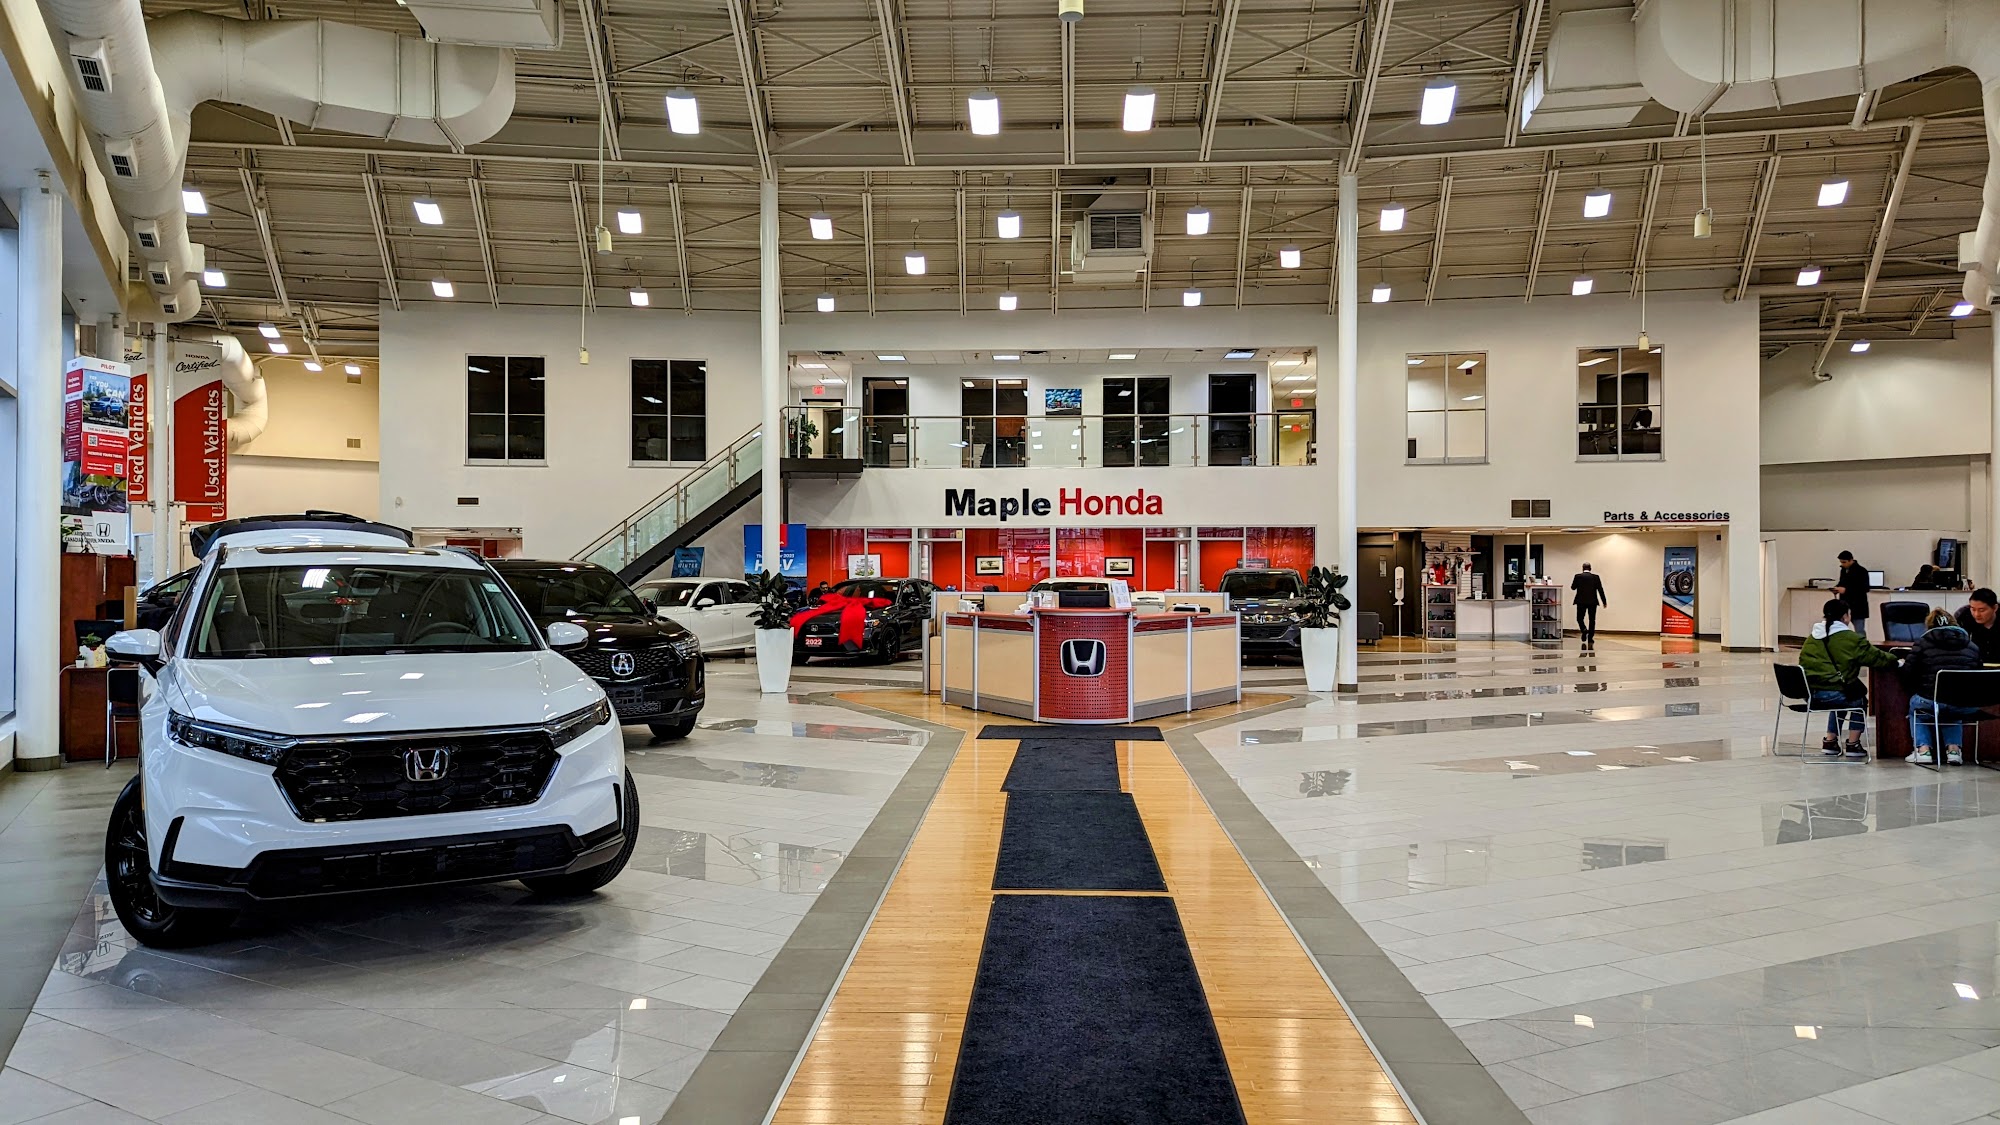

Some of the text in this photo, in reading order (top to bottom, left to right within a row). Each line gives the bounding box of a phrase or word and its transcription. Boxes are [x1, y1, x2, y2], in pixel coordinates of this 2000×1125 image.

[100, 363, 116, 371] PILOT
[175, 359, 220, 373] Certified
[95, 380, 109, 388] YOU
[105, 388, 125, 399] CAN
[203, 389, 219, 455] Vehicles
[128, 383, 144, 496] Used Vehicles
[203, 458, 220, 498] Used
[945, 488, 1163, 521] Maple Honda
[1603, 510, 1730, 521] Parts & Accessories
[805, 638, 822, 646] 2022
